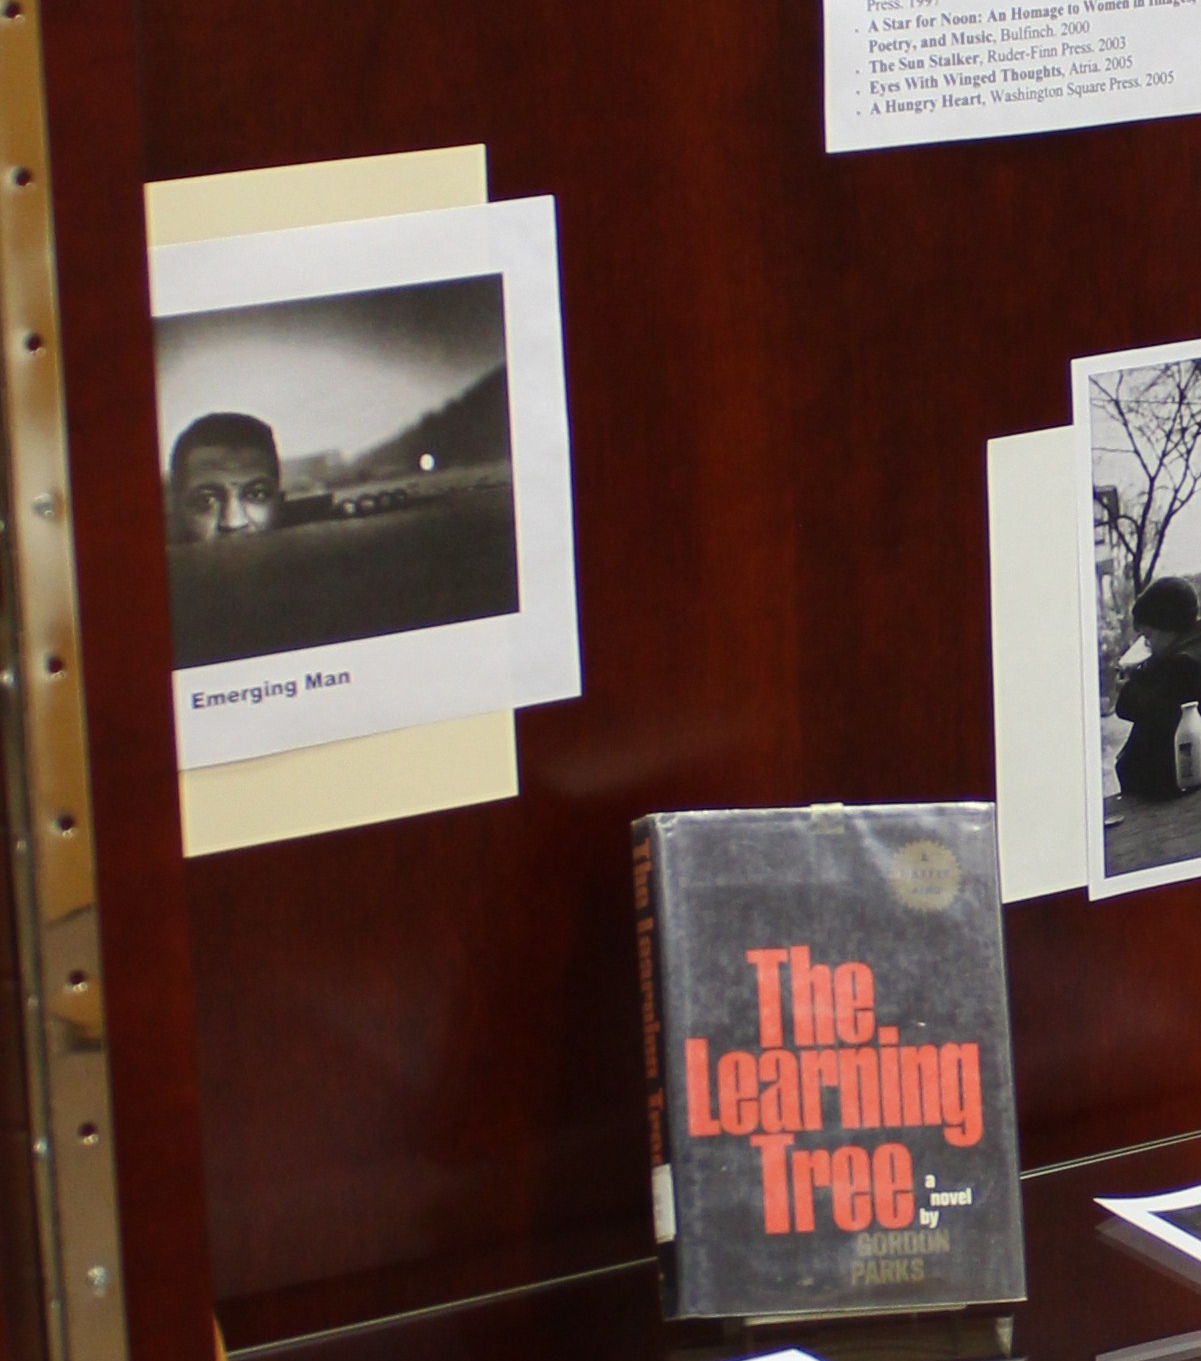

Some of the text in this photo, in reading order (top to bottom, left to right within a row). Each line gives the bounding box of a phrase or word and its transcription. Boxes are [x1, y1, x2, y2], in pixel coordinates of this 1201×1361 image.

[868, 19, 878, 32] A
[882, 17, 912, 31] Star
[916, 14, 936, 28] for
[940, 12, 982, 26] Noon:
[987, 9, 1006, 22] An
[1011, 6, 1064, 20] Homage
[1067, 3, 1079, 15] to
[1083, 0, 1129, 12] Women
[920, 33, 946, 48] and
[1060, 20, 1089, 36] 2000
[192, 672, 350, 709] Emerging Man
[746, 945, 875, 1048] The
[685, 1026, 984, 1147] Learning
[750, 1133, 915, 1235] Tree
[924, 1174, 935, 1188] a
[930, 1188, 972, 1206] novel
[920, 1208, 939, 1229] by
[856, 1230, 950, 1257] GORDON
[850, 1258, 924, 1286] PARKS
